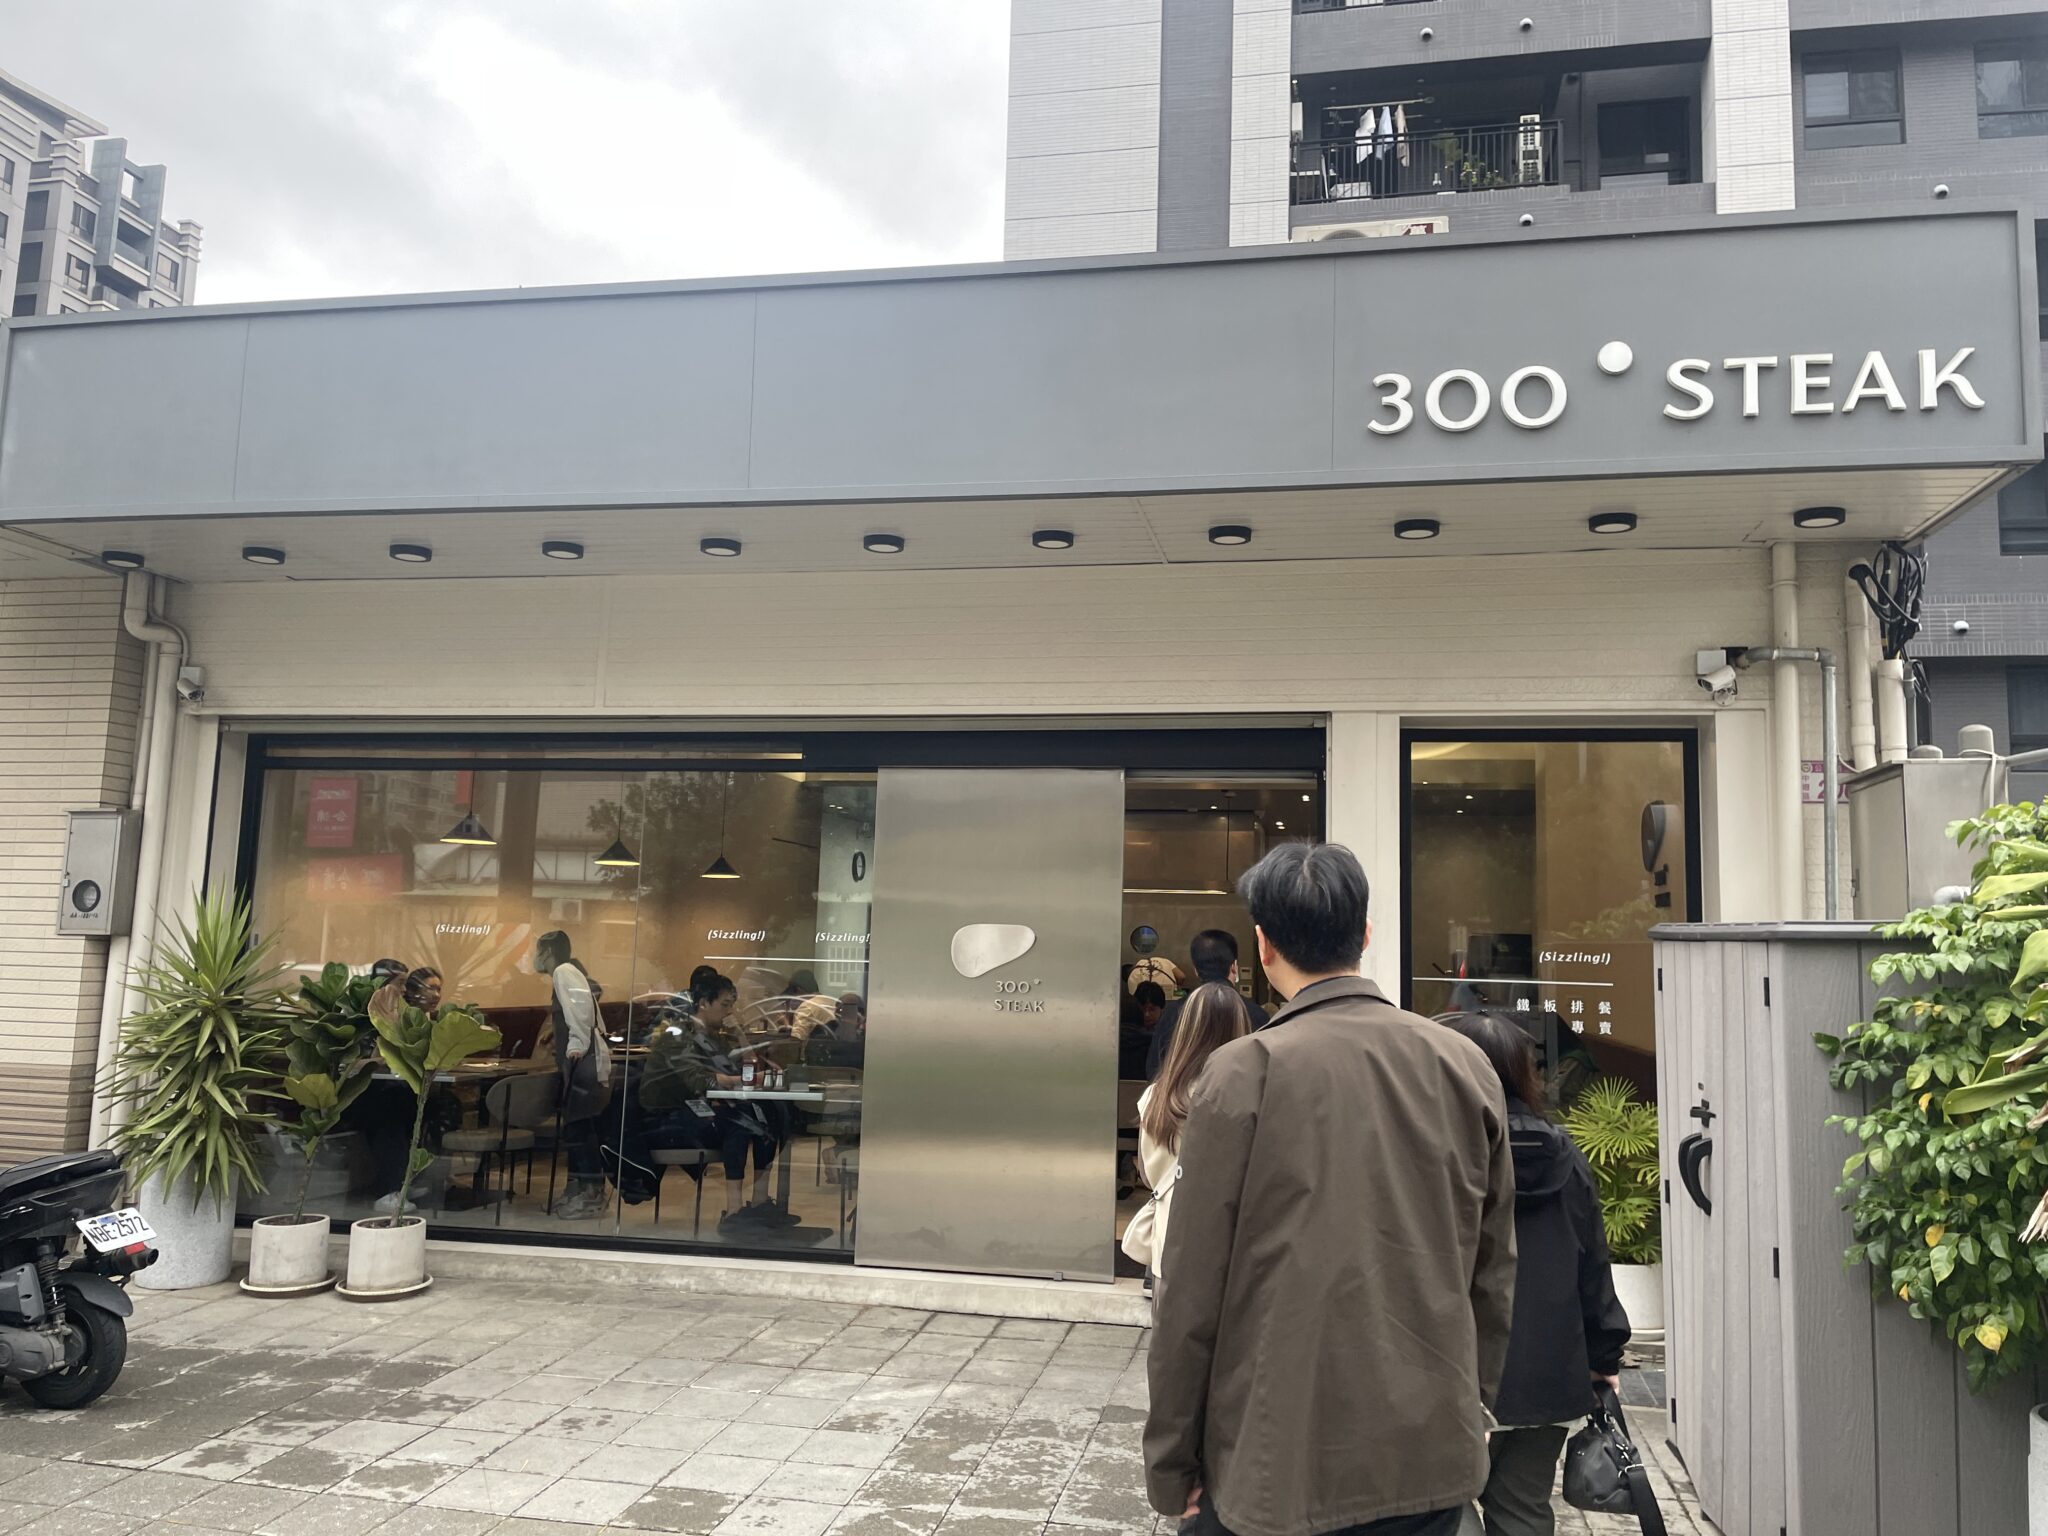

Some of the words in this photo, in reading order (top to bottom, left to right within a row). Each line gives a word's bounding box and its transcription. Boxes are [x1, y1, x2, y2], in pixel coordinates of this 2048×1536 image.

[1663, 347, 1985, 420] STEAK
[435, 923, 491, 936] (Sizzling!)
[707, 929, 766, 942] (Sizzling!)
[815, 931, 871, 944] (Sizzling!
[1539, 951, 1611, 965] (Sizzling!)
[994, 999, 1045, 1013] STEAK
